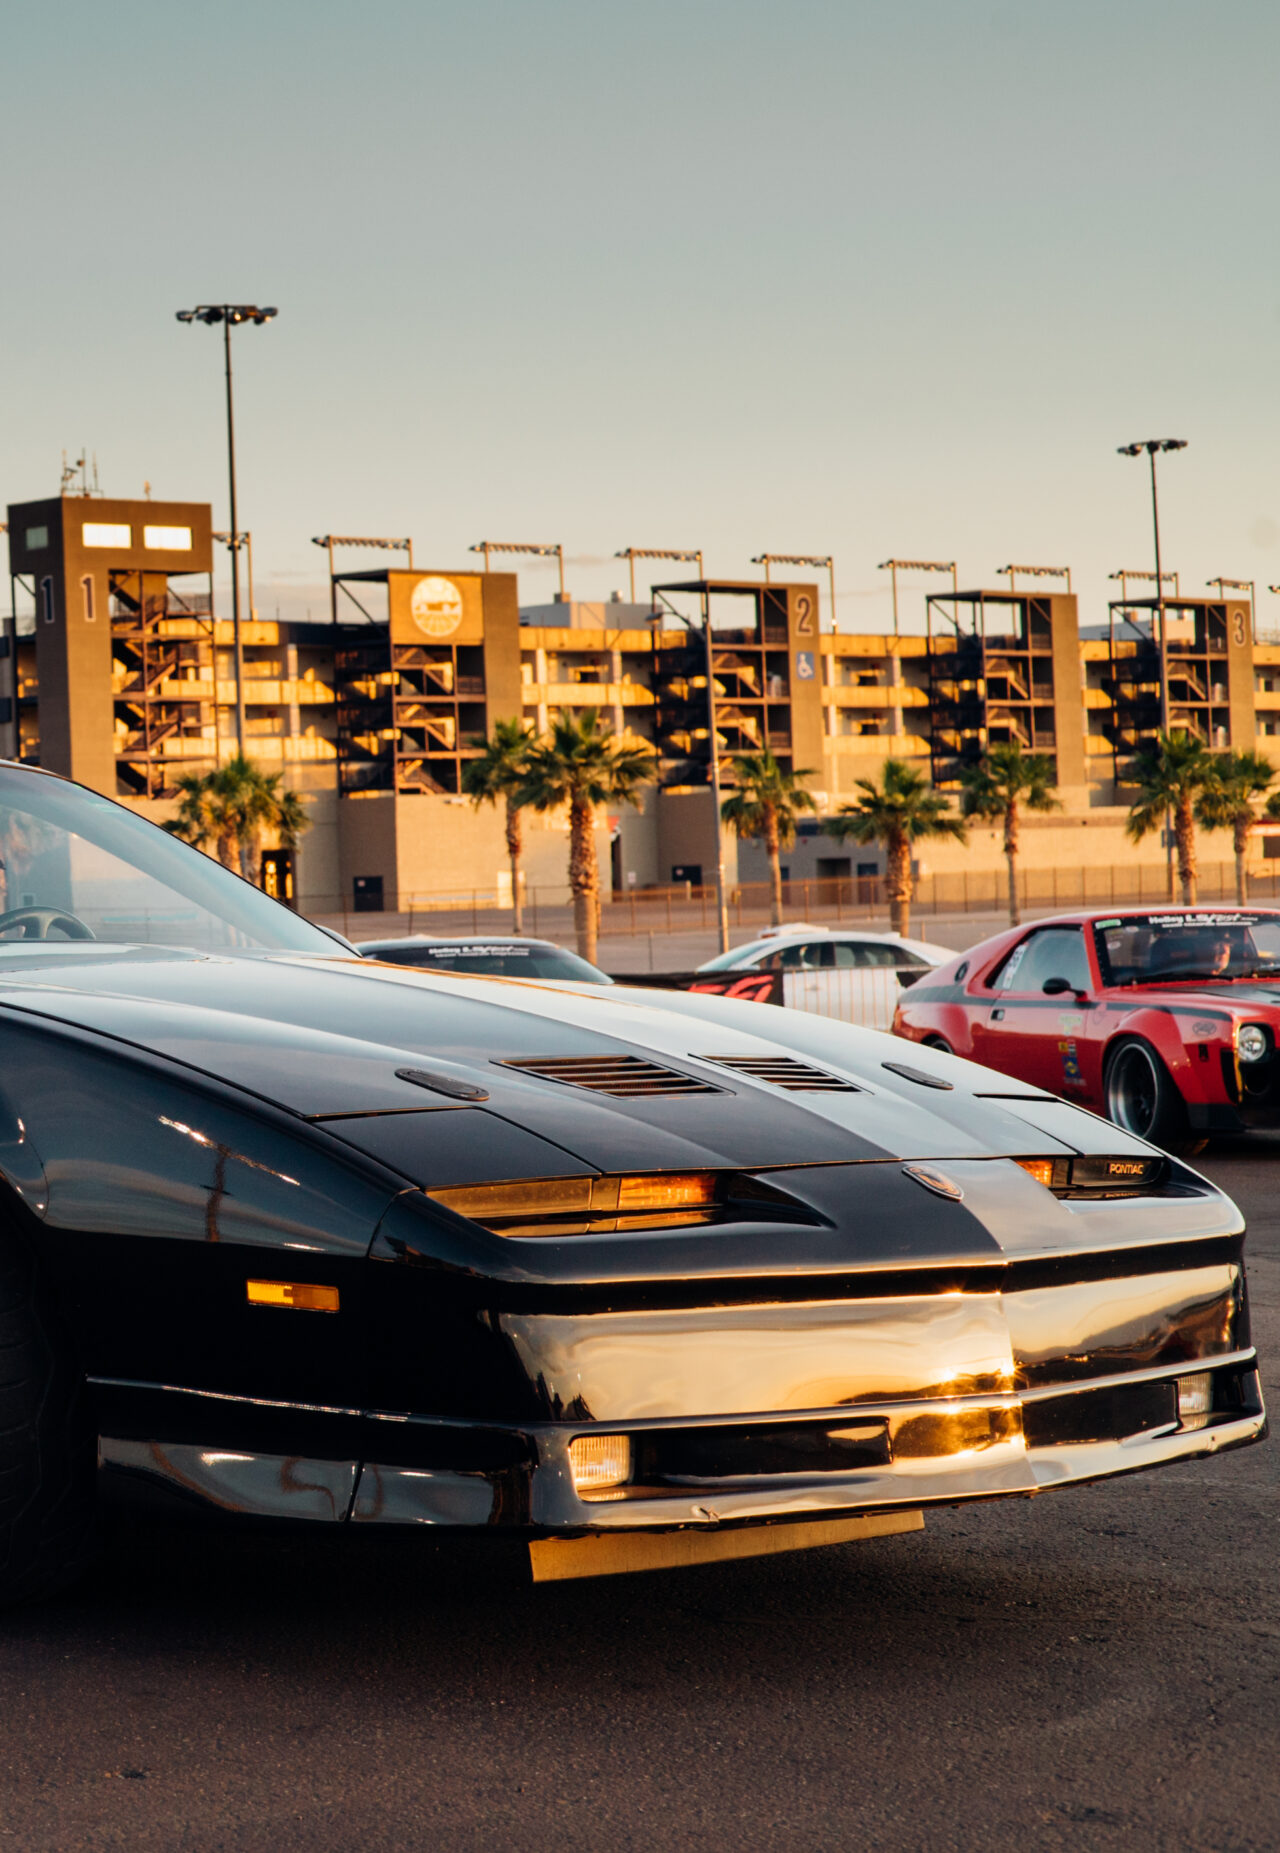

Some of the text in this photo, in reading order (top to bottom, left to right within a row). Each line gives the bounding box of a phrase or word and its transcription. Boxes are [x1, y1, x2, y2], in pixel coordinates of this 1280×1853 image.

[41, 575, 55, 623] 1
[80, 574, 96, 622] 1
[796, 594, 813, 637] 2
[1233, 609, 1247, 647] 3
[1109, 1163, 1144, 1175] PONTIAC
